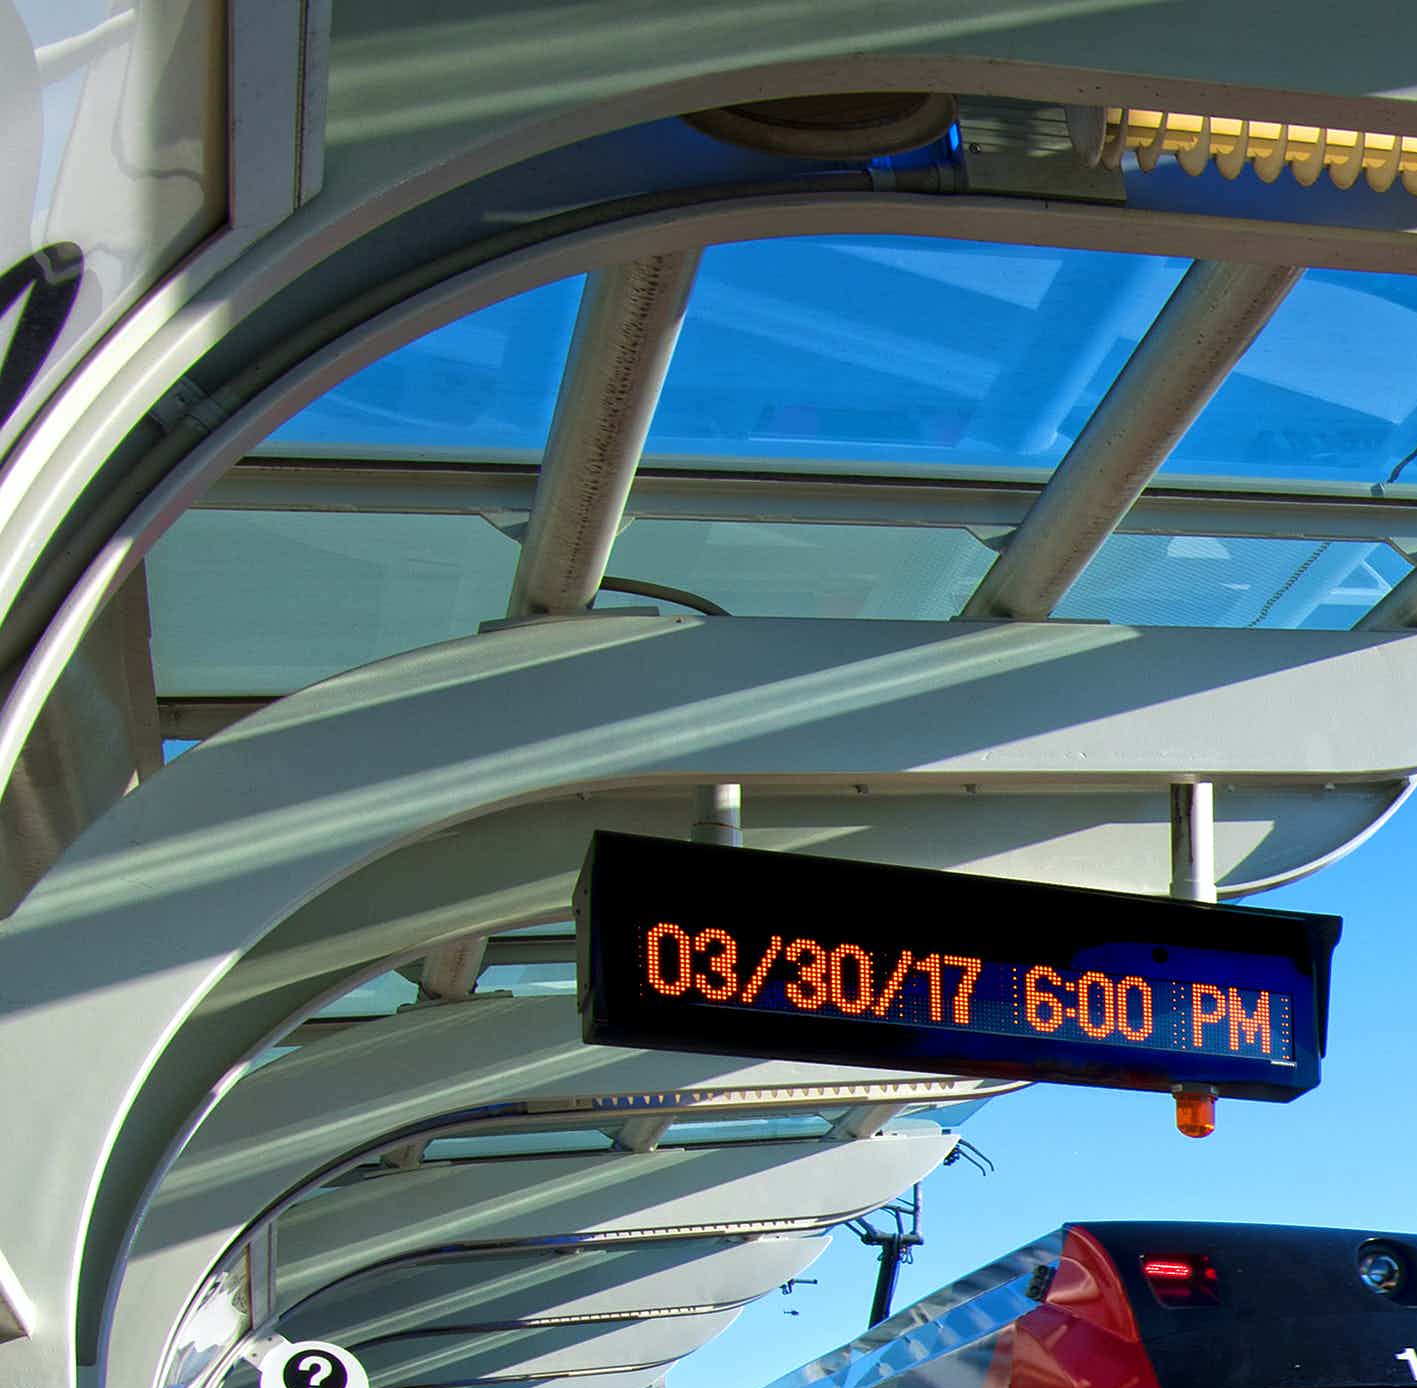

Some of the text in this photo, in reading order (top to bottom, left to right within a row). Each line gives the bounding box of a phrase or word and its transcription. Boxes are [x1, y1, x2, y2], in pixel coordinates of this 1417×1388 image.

[647, 923, 1271, 1054] 03/30/17 6:00 PM
